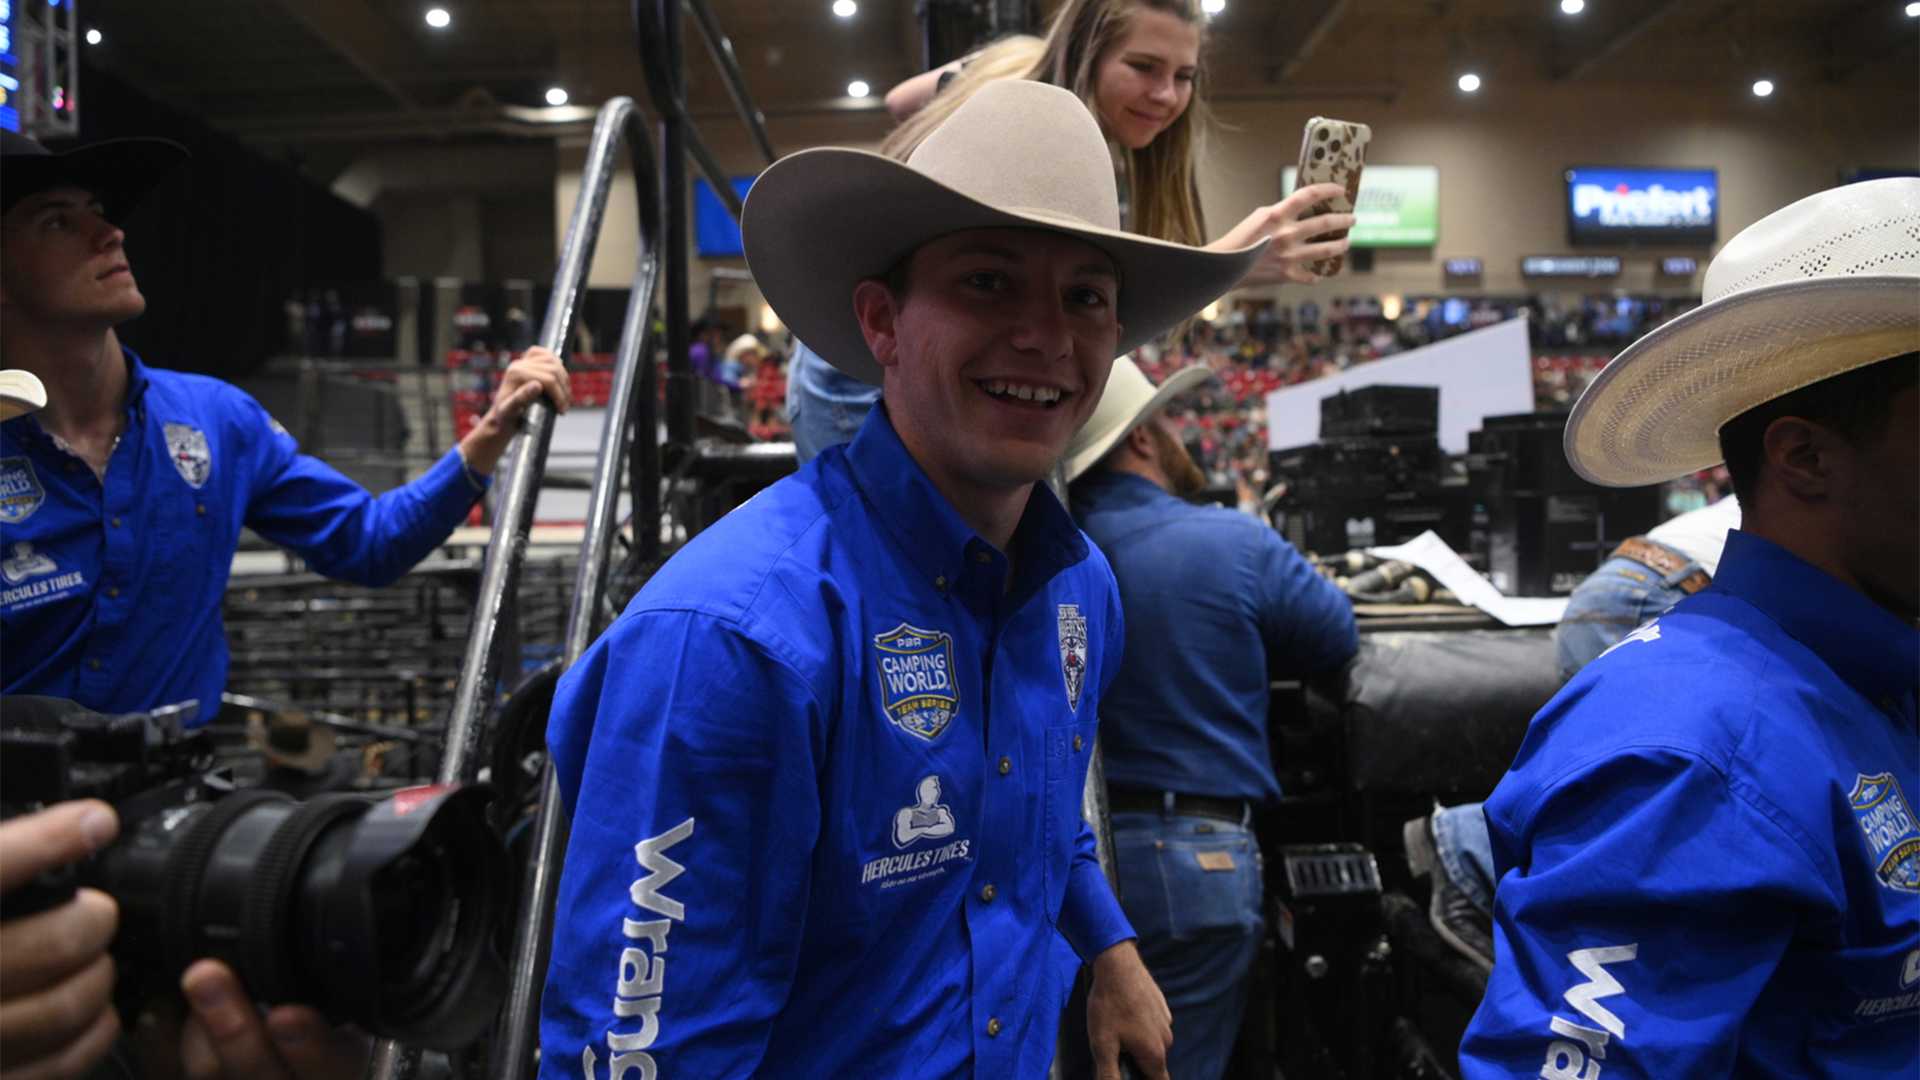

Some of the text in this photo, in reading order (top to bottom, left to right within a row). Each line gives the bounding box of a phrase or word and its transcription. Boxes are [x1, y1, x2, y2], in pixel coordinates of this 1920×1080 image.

[882, 653, 946, 674] CAMPING
[886, 670, 947, 694] WORLD
[1861, 794, 1902, 835] CAMPING
[1868, 812, 1910, 855] WORLD
[862, 849, 933, 883] HERCULES
[932, 839, 970, 865] TIRES
